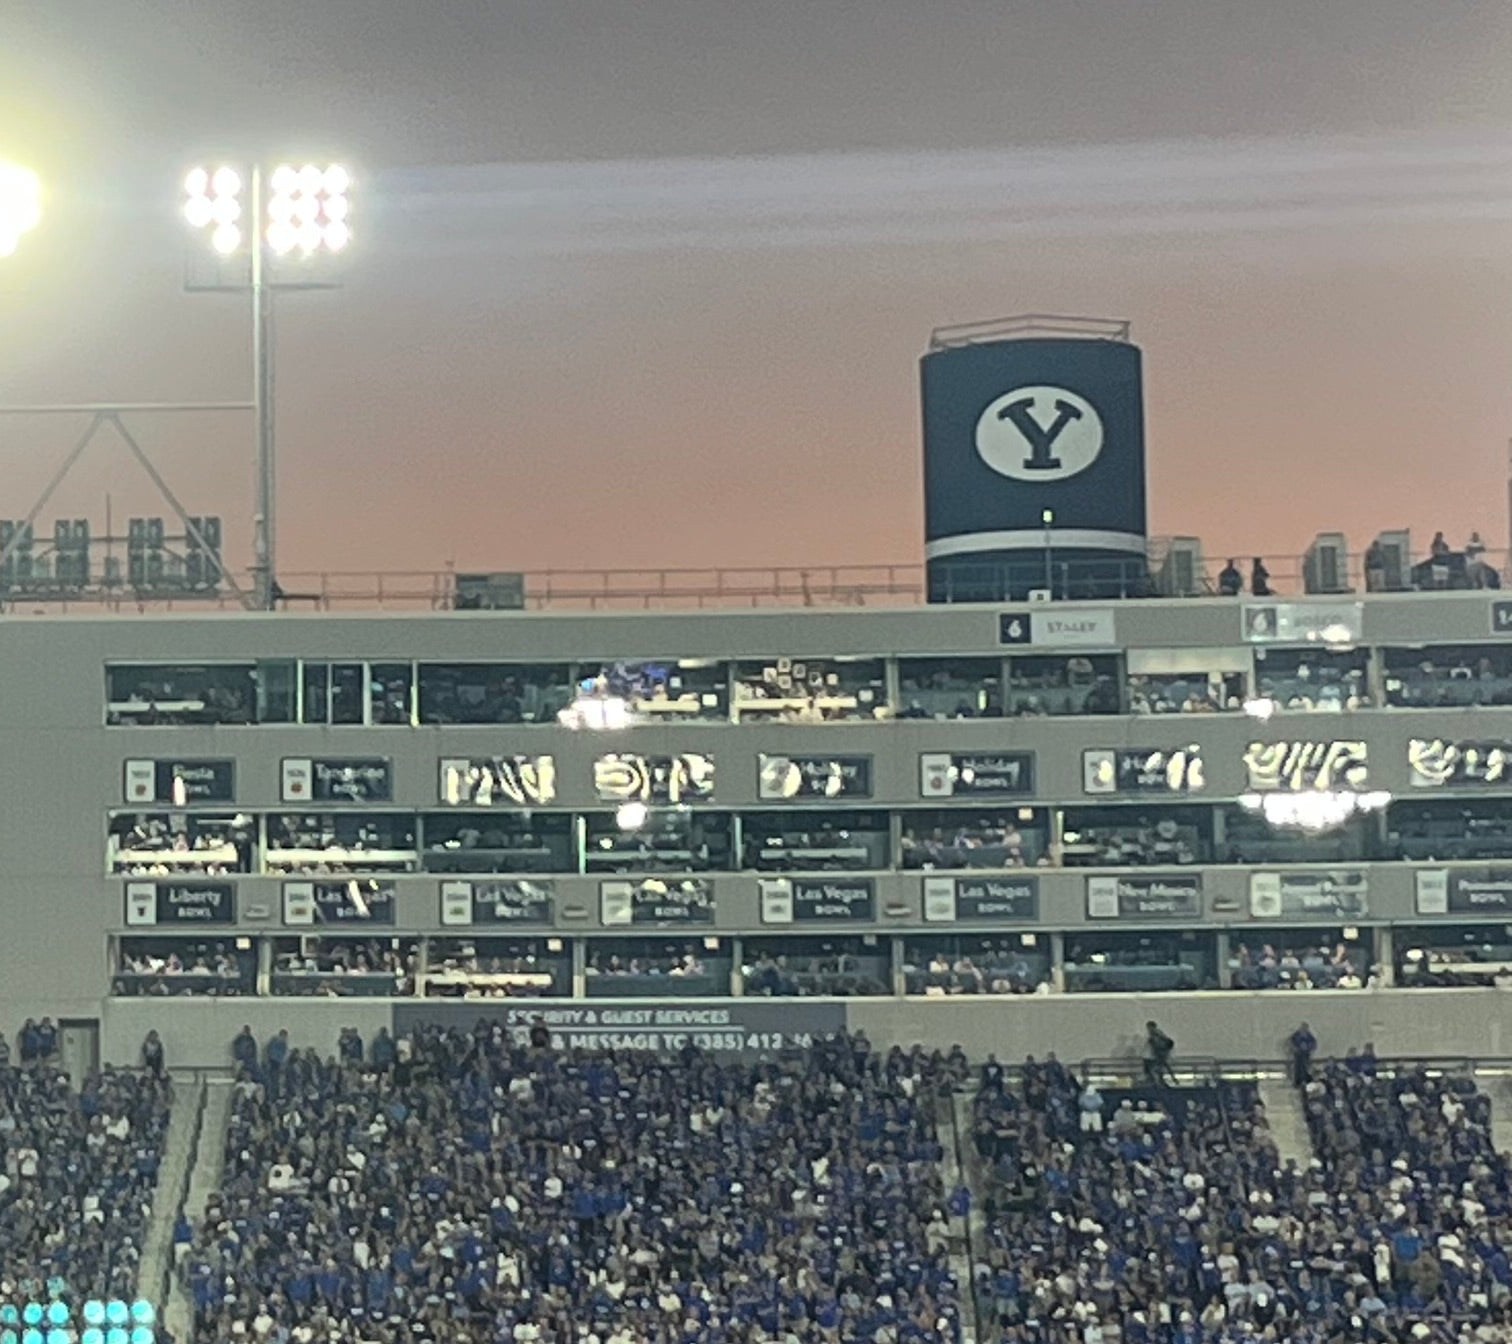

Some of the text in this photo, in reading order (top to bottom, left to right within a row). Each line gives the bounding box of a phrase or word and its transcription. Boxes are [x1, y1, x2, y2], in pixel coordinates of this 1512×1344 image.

[997, 397, 1083, 469] Y
[169, 887, 222, 907] Liberty
[796, 885, 823, 901] Las
[824, 885, 869, 904] Vegas
[959, 882, 986, 898] Las
[987, 882, 1031, 903] Vegas
[178, 906, 213, 918] BOWL
[815, 904, 851, 915] BOWL
[978, 902, 1014, 913] BOWL
[601, 1010, 651, 1024] GUEST
[654, 1009, 729, 1024] SERVICES
[569, 1033, 660, 1051] MESSAGE
